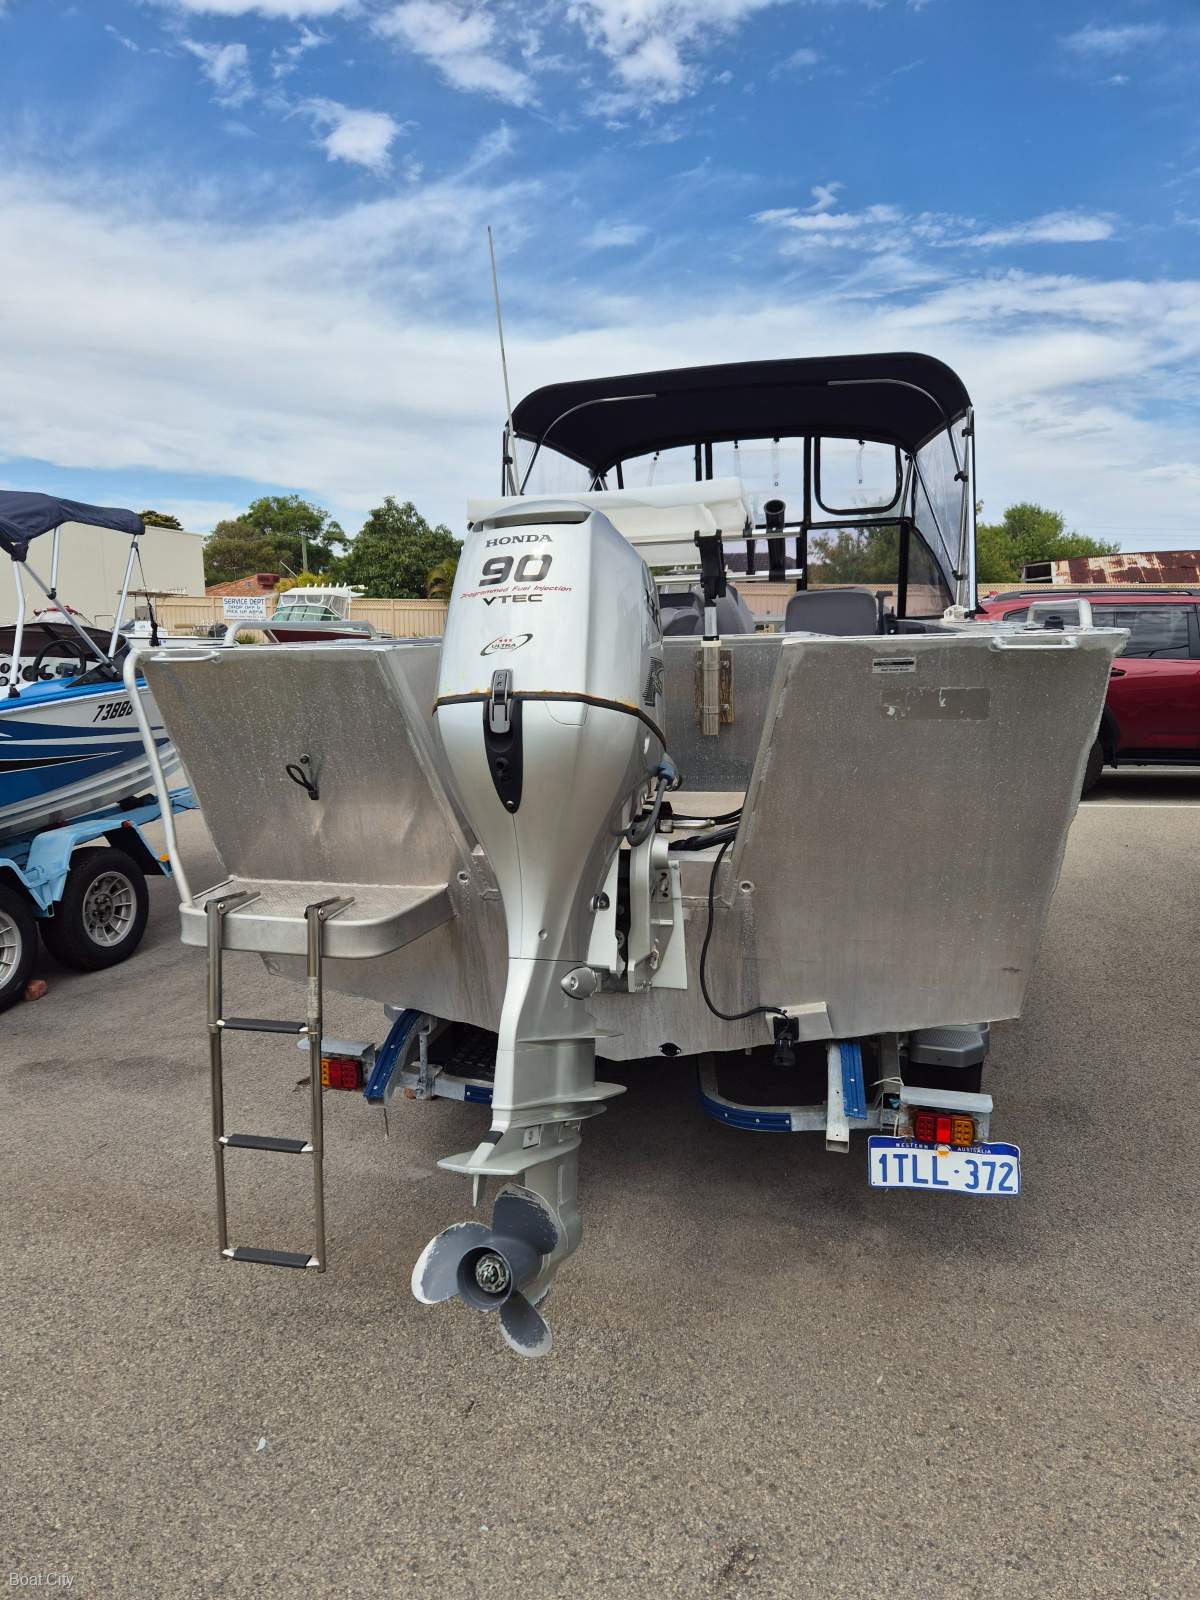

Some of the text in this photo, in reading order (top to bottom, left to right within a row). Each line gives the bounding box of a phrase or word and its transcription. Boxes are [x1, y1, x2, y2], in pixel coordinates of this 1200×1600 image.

[486, 534, 553, 547] HONDA
[478, 554, 553, 587] 90
[482, 594, 543, 606] VTEC
[957, 1146, 992, 1154] AUSTRALIA
